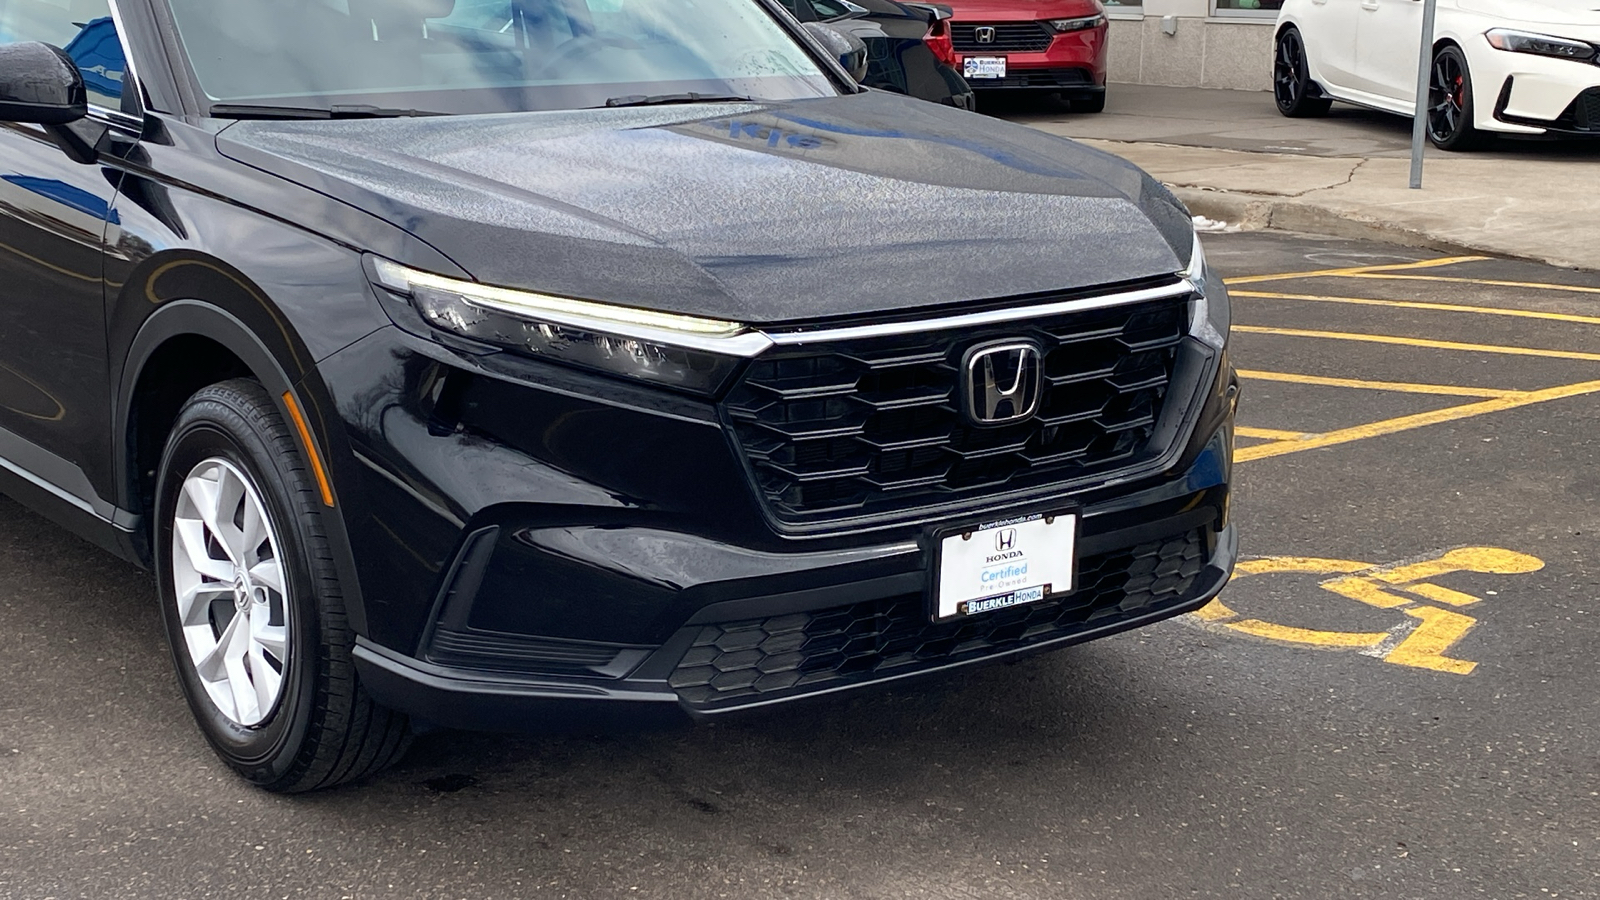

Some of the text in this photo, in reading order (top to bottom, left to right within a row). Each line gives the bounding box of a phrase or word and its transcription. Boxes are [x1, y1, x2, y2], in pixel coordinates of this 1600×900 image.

[979, 65, 1005, 73] HONDA
[986, 550, 1024, 563] HONDA
[981, 563, 1028, 582] Certified
[968, 589, 1042, 613] BUERKLE HONDA
